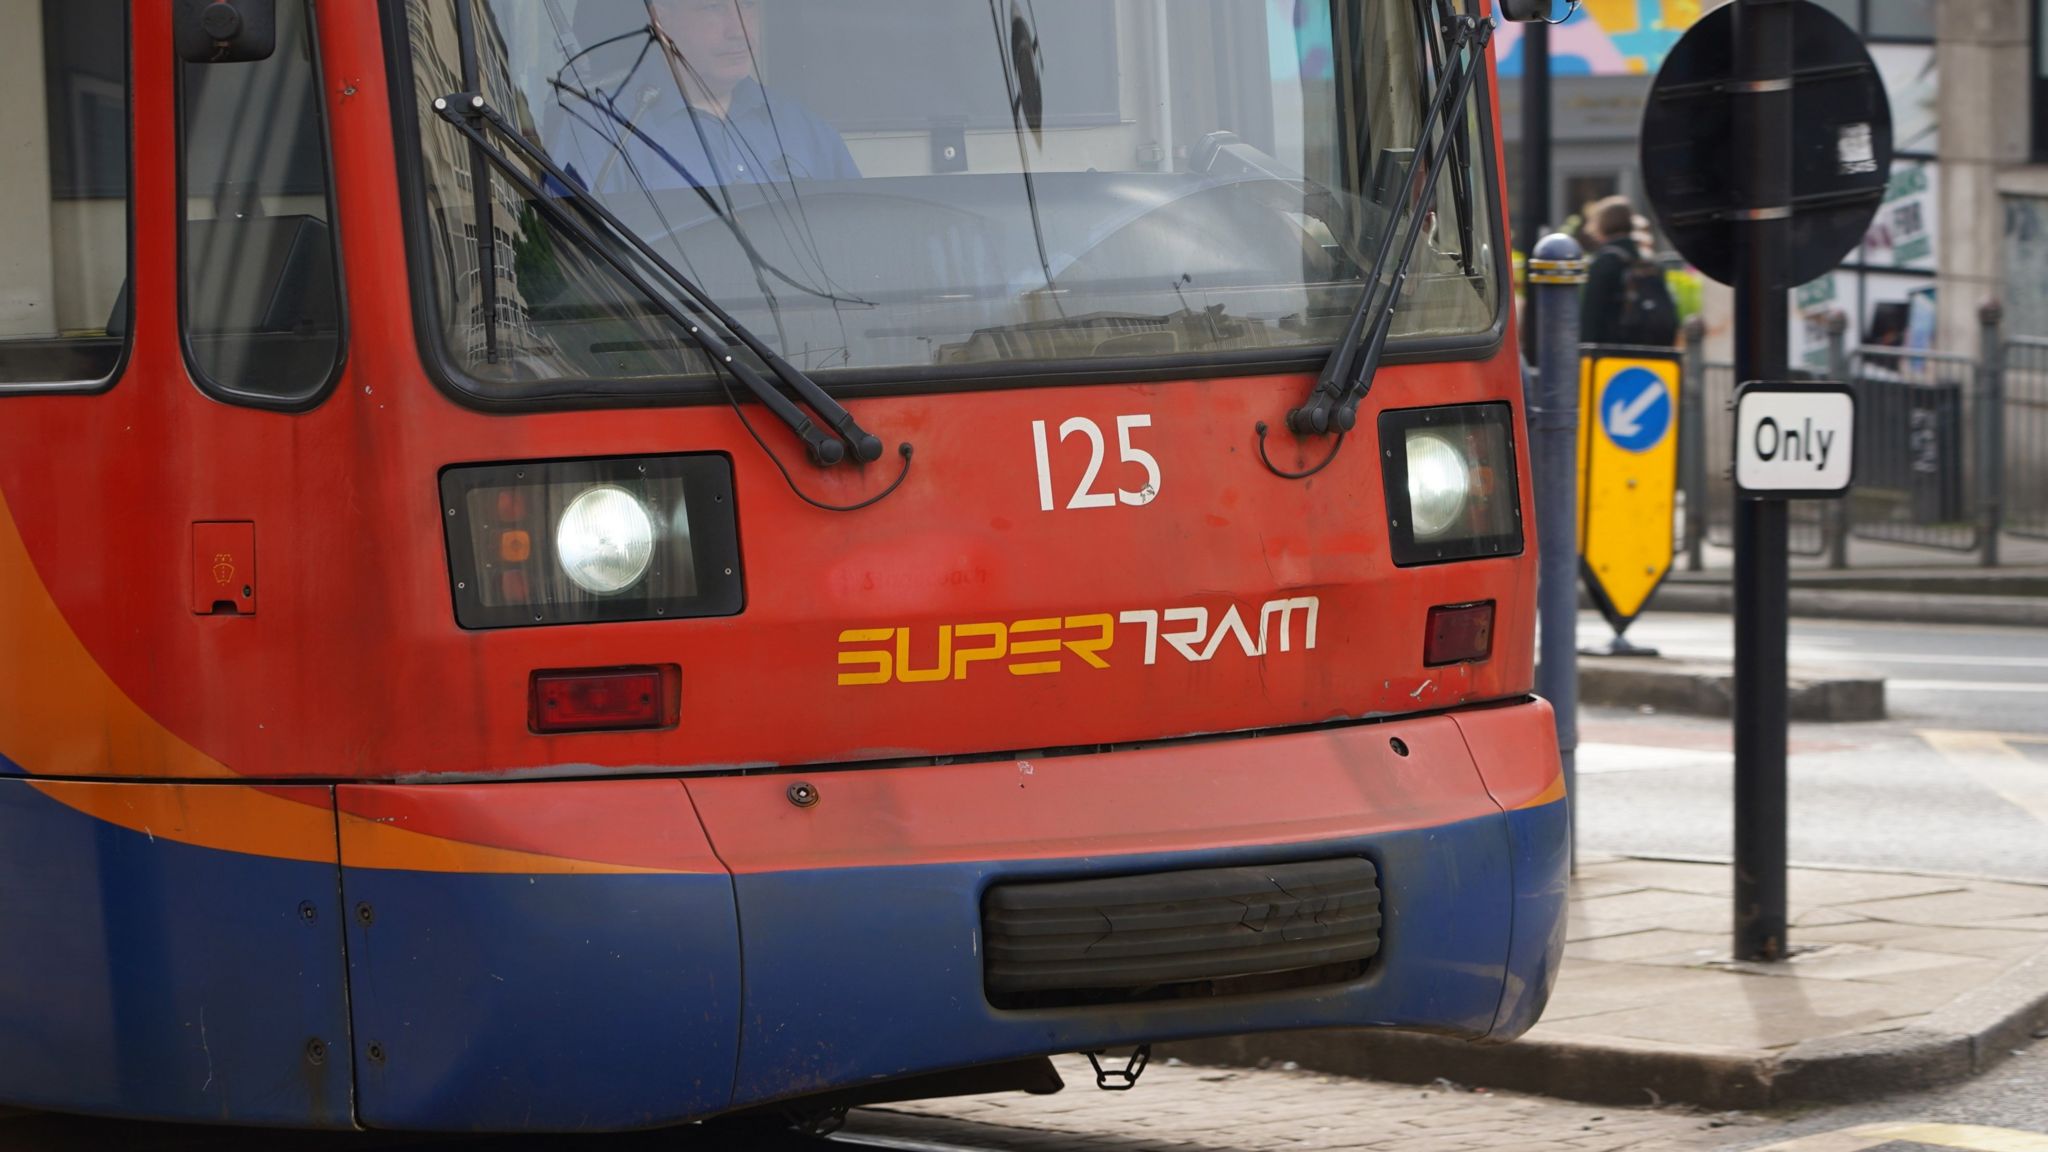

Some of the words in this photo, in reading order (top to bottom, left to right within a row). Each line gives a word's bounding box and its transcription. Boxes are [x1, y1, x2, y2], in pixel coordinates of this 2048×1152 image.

[1032, 414, 1161, 511] 125
[1755, 417, 1834, 471] Only
[837, 596, 1319, 685] SUPERTRAM
